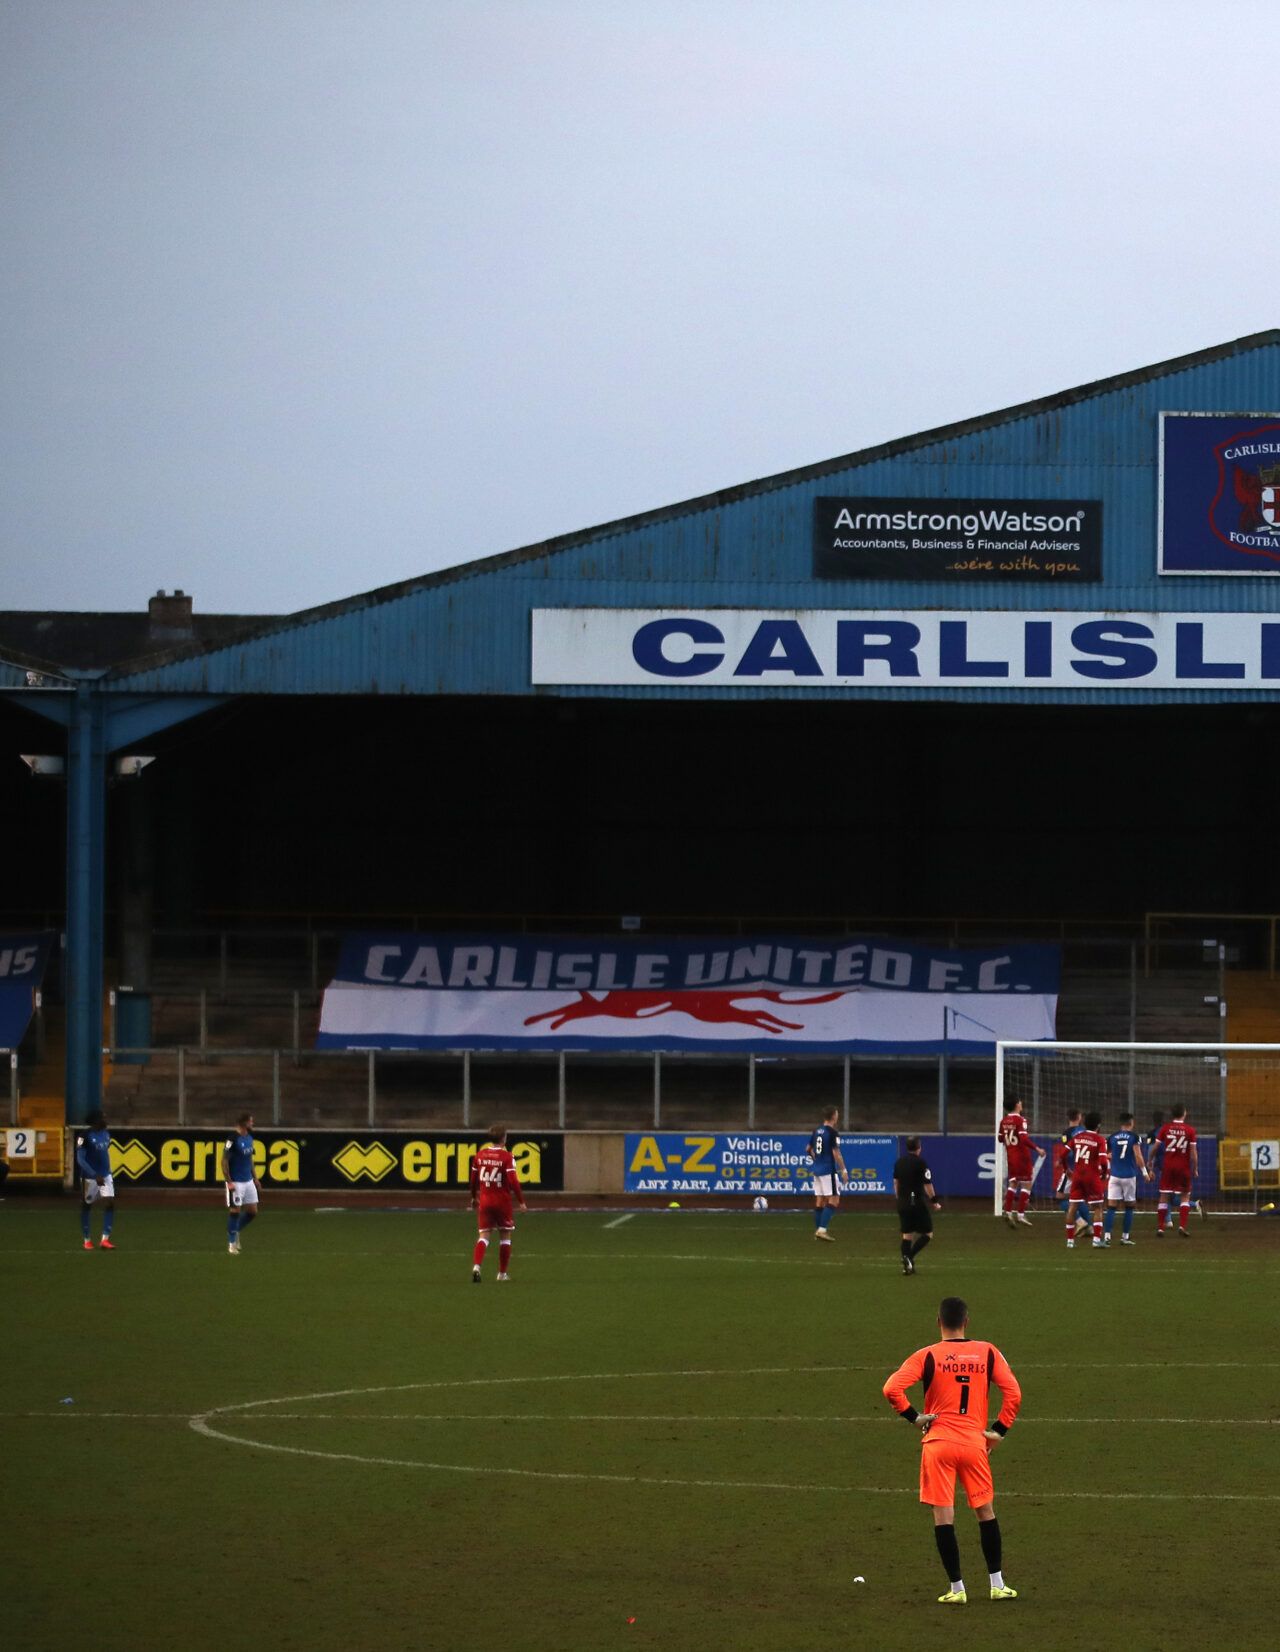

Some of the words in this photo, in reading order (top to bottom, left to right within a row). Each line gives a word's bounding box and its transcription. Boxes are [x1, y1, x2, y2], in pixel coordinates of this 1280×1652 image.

[833, 538, 909, 551] Accountants,
[912, 538, 963, 550] Business
[966, 540, 975, 550] &
[977, 540, 1028, 551] Financial
[1030, 541, 1080, 551] Advisers
[1000, 556, 1040, 571] with
[1045, 562, 1080, 575] you
[365, 945, 670, 990] CARLISLE
[683, 943, 912, 986] UNITED
[928, 955, 1034, 992] F.C.
[14, 1132, 28, 1154] 2
[727, 1137, 783, 1152] Vehicle
[815, 1135, 823, 1155] 8
[1004, 1129, 1019, 1147] 16
[1166, 1135, 1189, 1153] 24
[629, 1136, 716, 1174] A-Z
[722, 1151, 814, 1166] Dismantlers
[1074, 1143, 1091, 1165] 14
[1116, 1140, 1129, 1159] 7
[402, 1140, 542, 1183] erra
[480, 1166, 502, 1187] 44
[721, 1167, 791, 1179] 01228
[796, 1167, 877, 1179] 555
[637, 1180, 668, 1190] ANY
[672, 1180, 711, 1193] PART,
[714, 1180, 746, 1191] ANY
[749, 1181, 797, 1194] MAKE,
[838, 1181, 886, 1191] MODEL
[942, 1363, 986, 1374] MORRIS
[955, 1376, 970, 1415] 1
